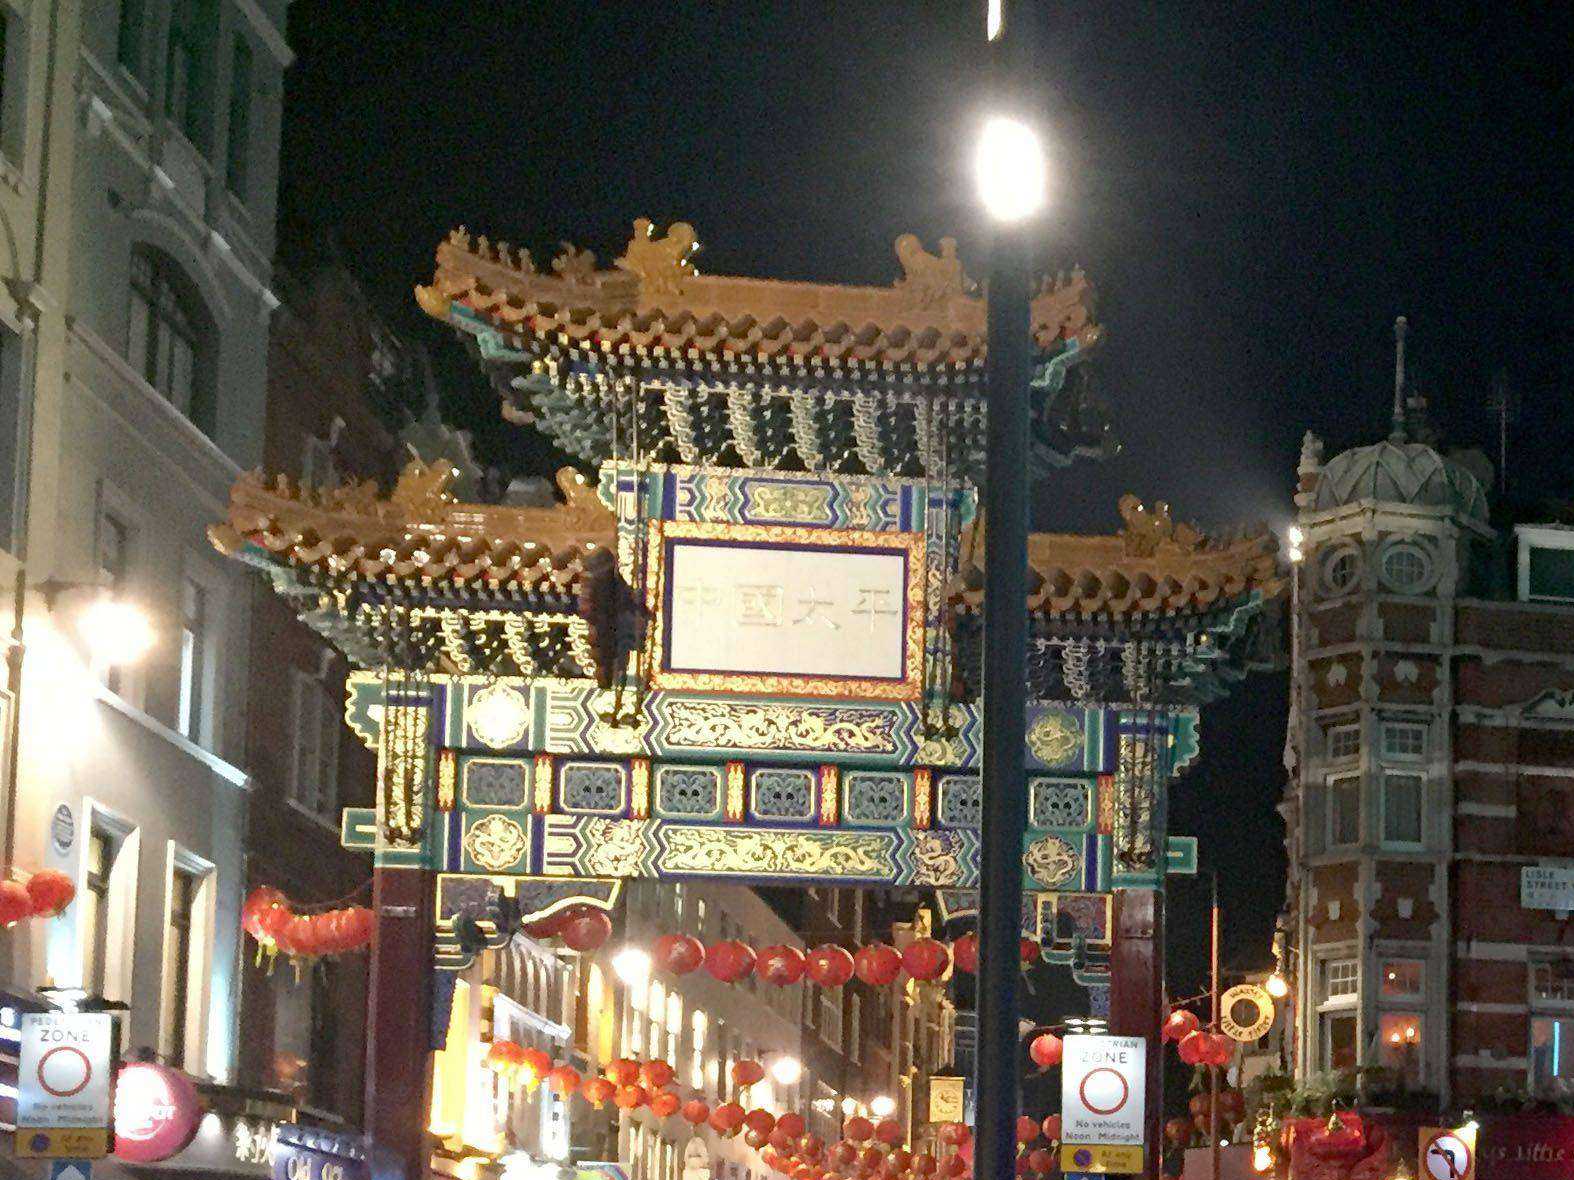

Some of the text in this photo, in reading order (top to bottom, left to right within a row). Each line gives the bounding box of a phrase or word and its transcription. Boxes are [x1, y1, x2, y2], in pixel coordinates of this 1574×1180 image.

[41, 1029, 90, 1042] ZONE
[1081, 1050, 1128, 1064] ZONE
[1075, 1120, 1131, 1129] No vehicles
